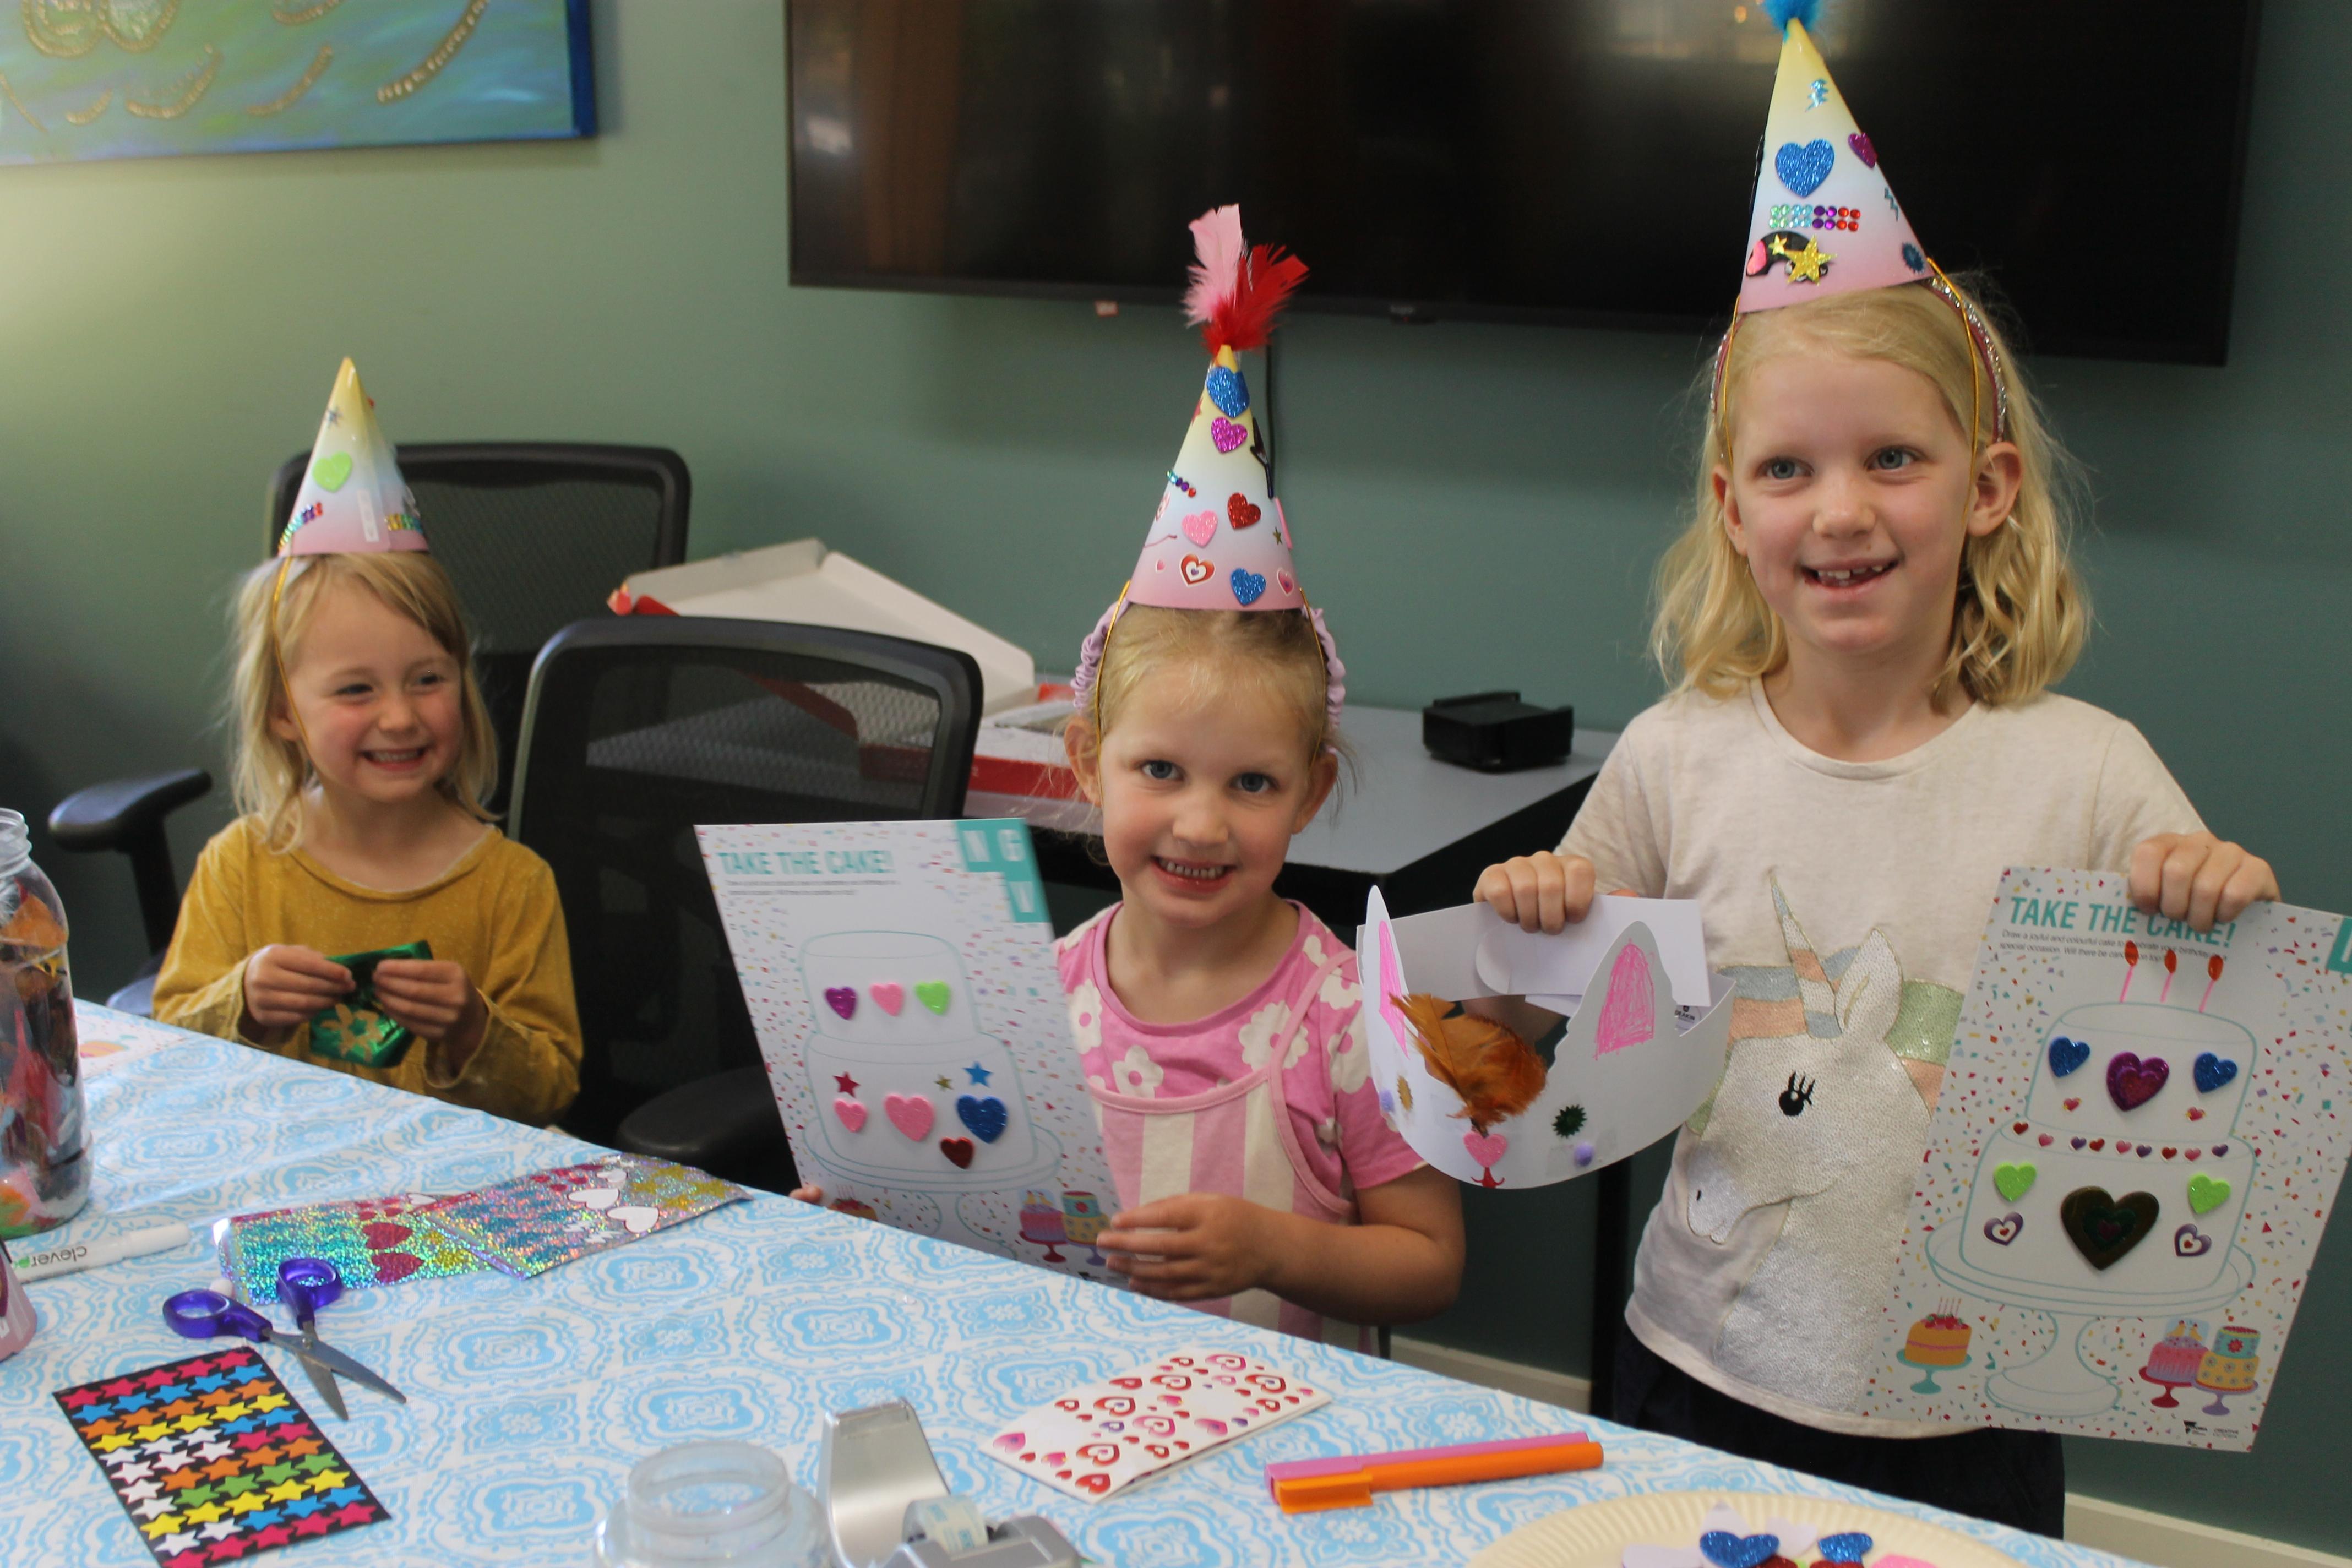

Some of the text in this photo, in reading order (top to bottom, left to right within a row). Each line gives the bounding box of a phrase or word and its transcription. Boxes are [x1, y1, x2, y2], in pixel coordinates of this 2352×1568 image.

[717, 852, 773, 875] TAKE
[774, 851, 823, 874] THE
[2011, 896, 2079, 929] TAKE
[2088, 903, 2139, 934] THE
[2002, 929, 2021, 938] Draw
[2063, 946, 2077, 955] Will
[2077, 948, 2097, 956] there
[2097, 949, 2108, 957] be
[31, 1245, 87, 1267] clever
